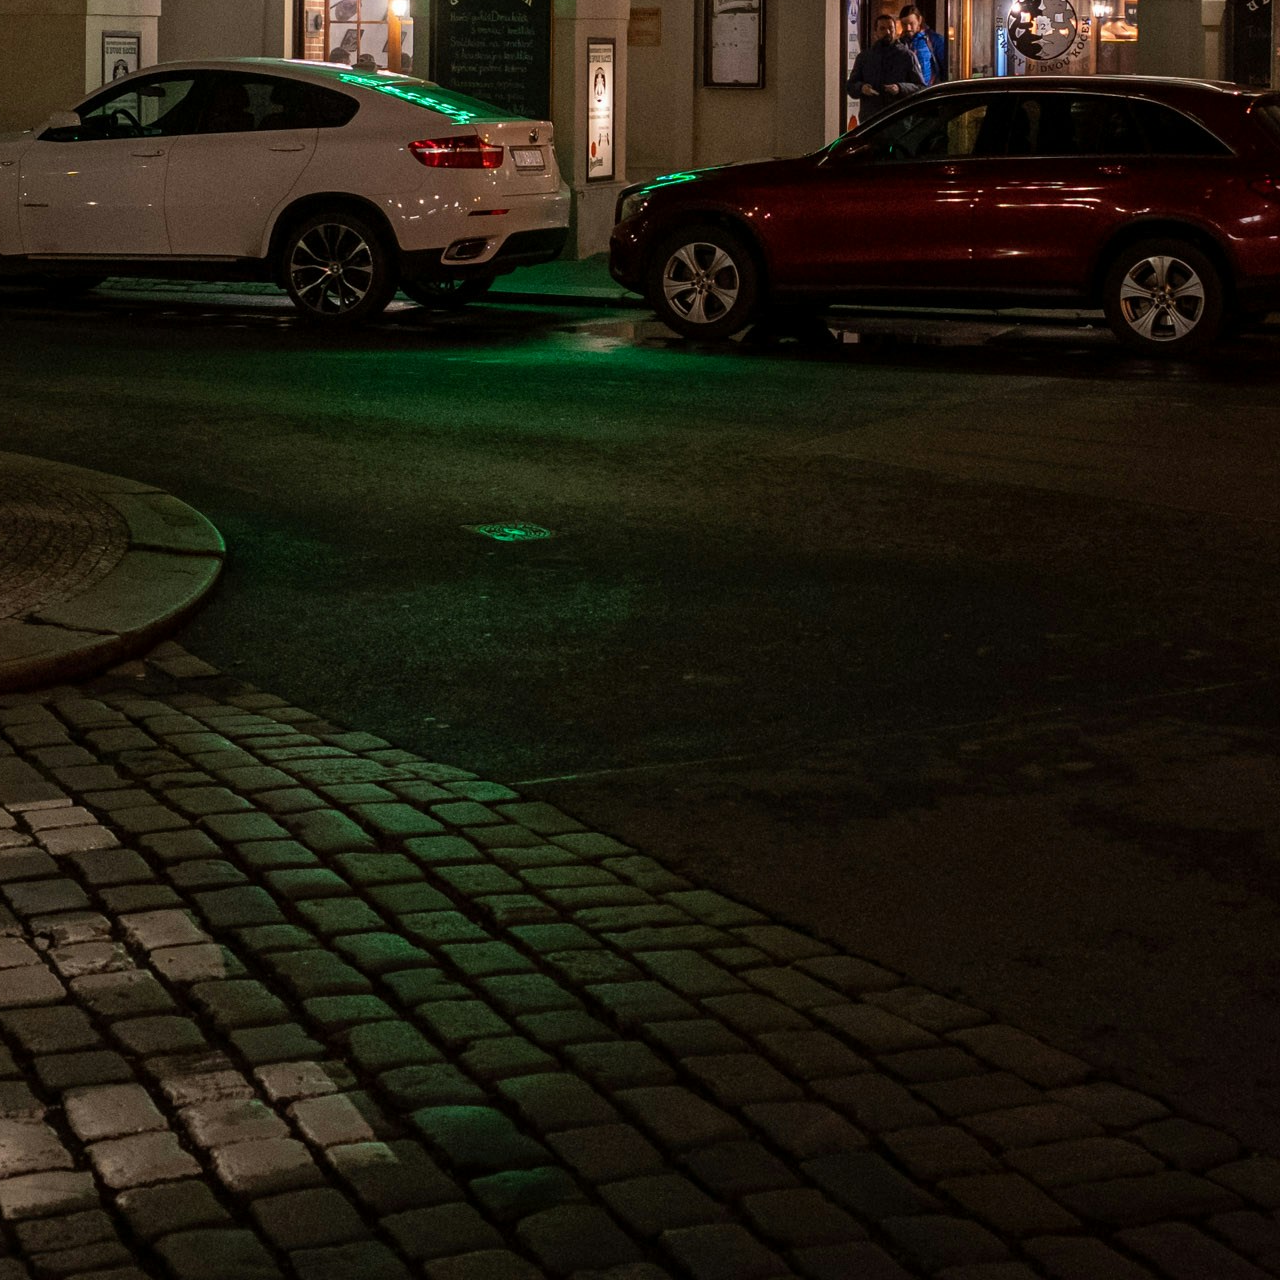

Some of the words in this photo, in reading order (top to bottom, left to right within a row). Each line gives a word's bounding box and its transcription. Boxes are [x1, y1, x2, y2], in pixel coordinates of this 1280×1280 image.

[1246, 0, 1260, 12] U
[995, 16, 1026, 68] BREWERY
[1028, 63, 1036, 73] U
[1040, 55, 1071, 74] DVOU
